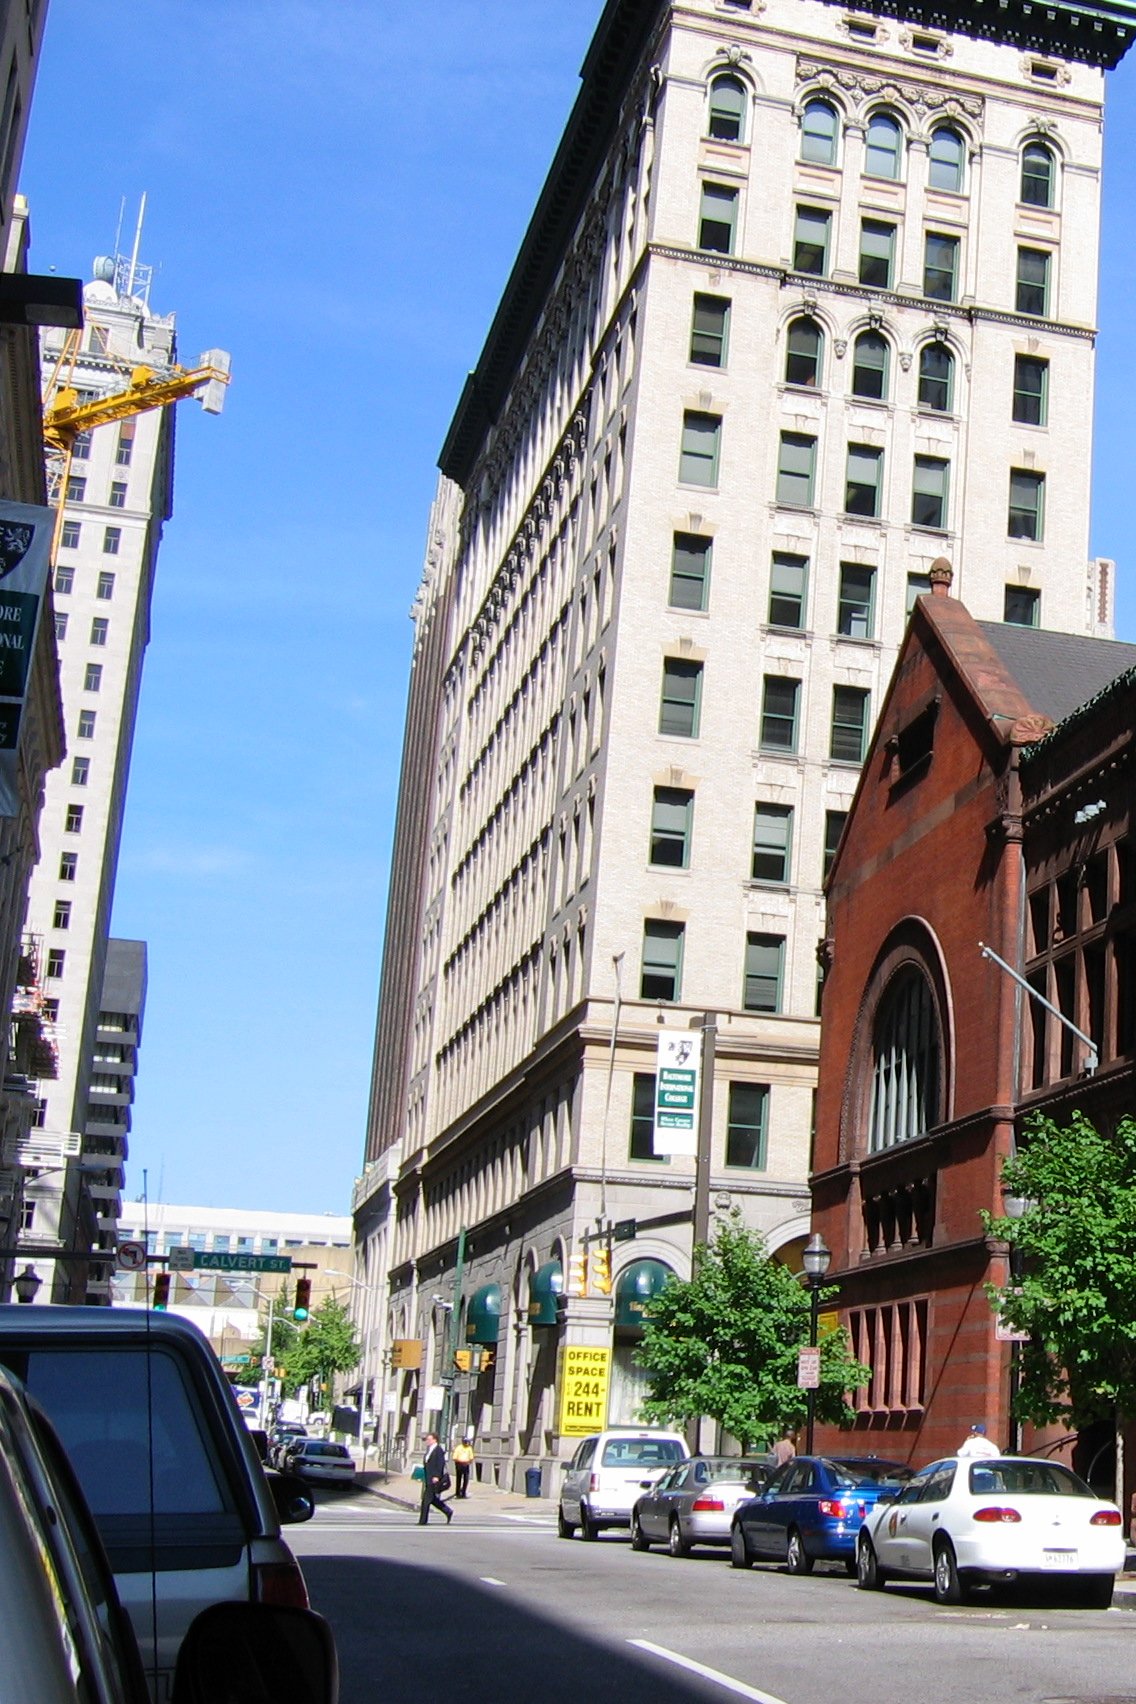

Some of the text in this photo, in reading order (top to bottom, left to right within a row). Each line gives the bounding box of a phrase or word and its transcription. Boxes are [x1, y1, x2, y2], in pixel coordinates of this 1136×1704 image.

[201, 1254, 264, 1269] CALVERT
[270, 1260, 287, 1269] ST.
[568, 1351, 607, 1362] OFFICE
[567, 1366, 606, 1377] SPACE
[573, 1381, 606, 1397] 244-
[567, 1401, 602, 1417] RENT
